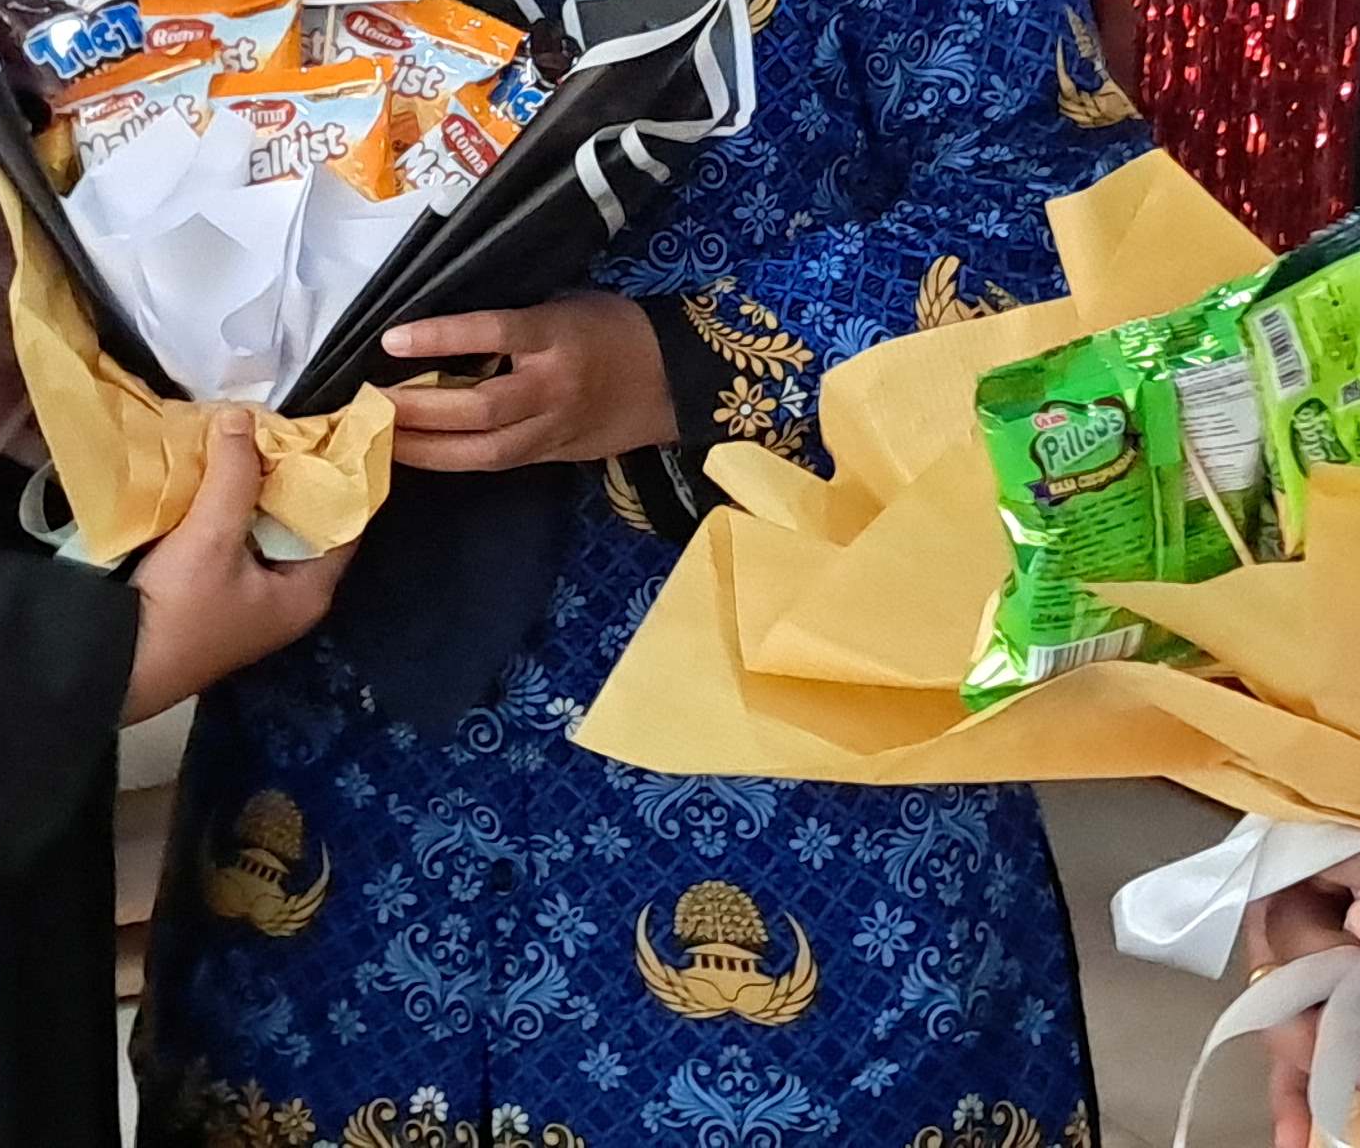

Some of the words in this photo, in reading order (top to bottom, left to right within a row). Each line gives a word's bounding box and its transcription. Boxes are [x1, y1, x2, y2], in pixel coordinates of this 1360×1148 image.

[249, 120, 348, 186] alkist
[444, 119, 490, 177] Roma
[1041, 412, 1125, 471] Pillows
